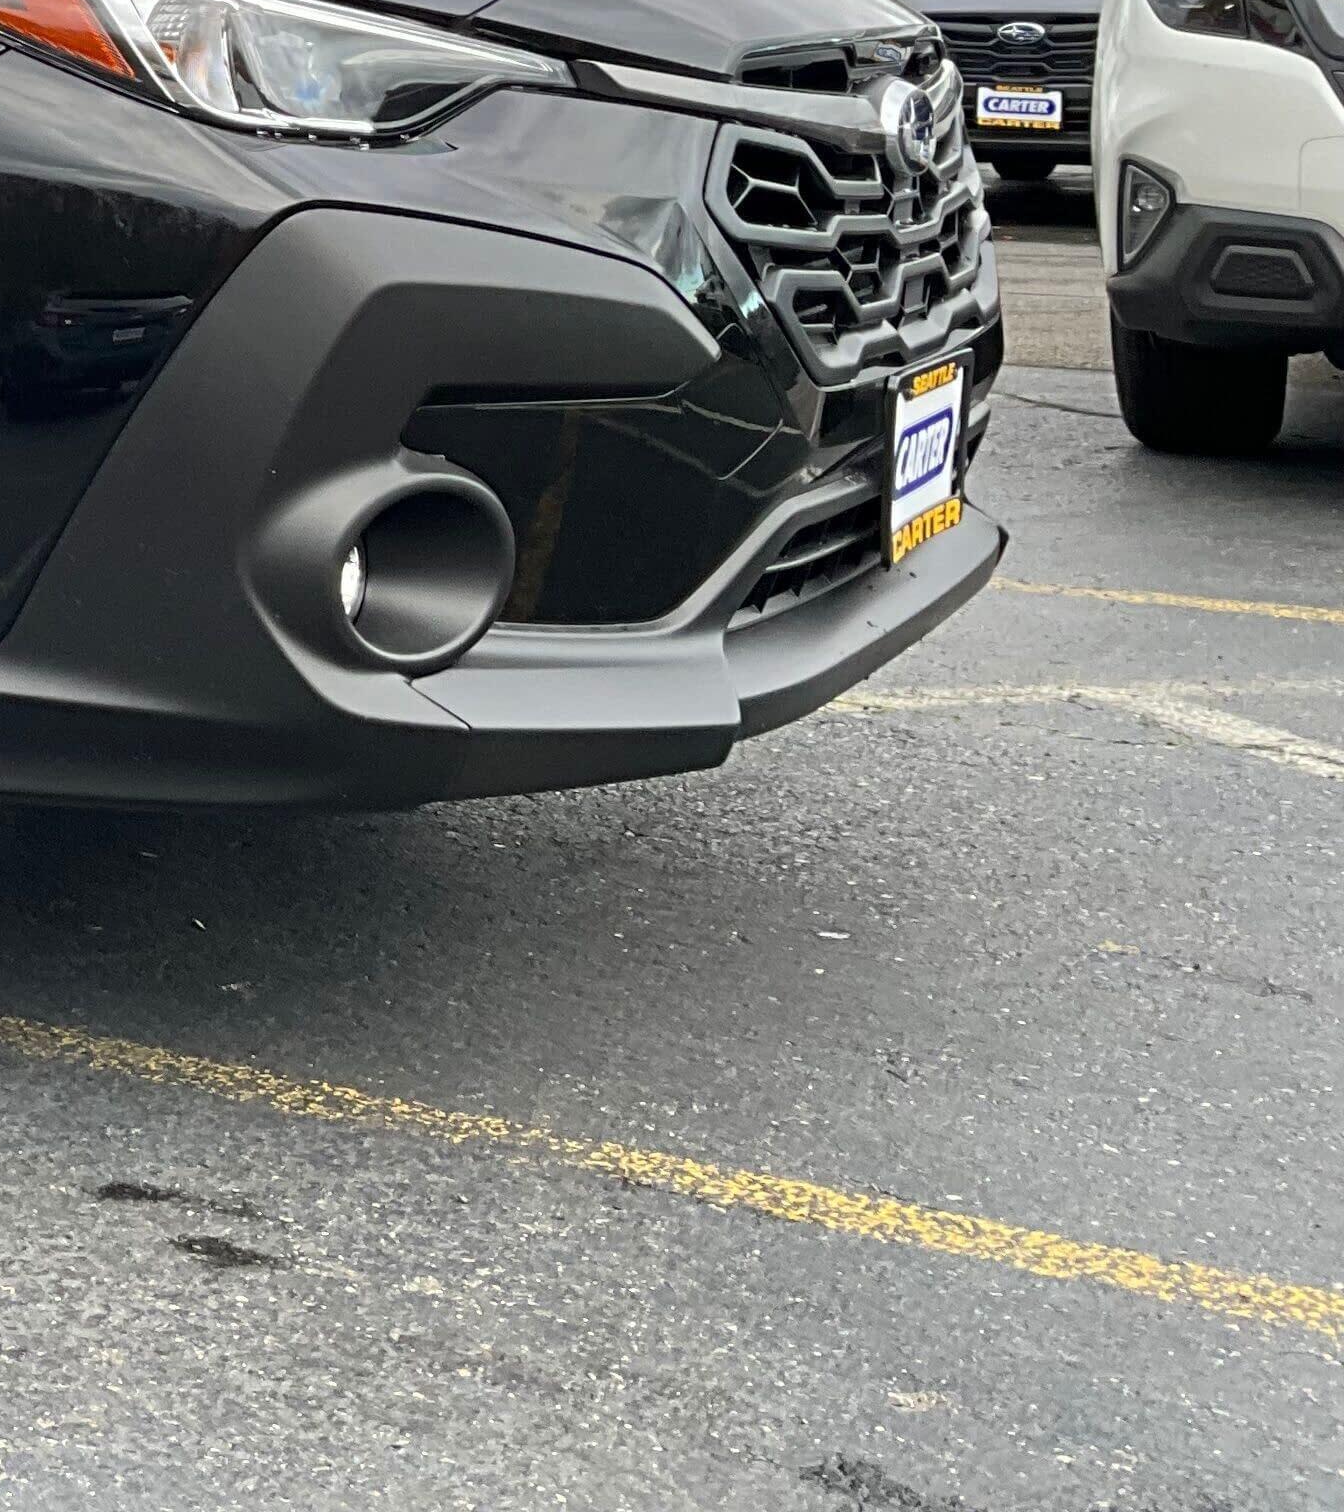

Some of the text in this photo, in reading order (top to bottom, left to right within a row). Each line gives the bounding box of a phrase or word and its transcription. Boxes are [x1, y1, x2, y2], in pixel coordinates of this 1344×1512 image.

[988, 98, 1050, 114] CARTER
[912, 361, 956, 396] SEATTLE
[895, 417, 951, 492] CARTER
[892, 497, 962, 565] CARTER
